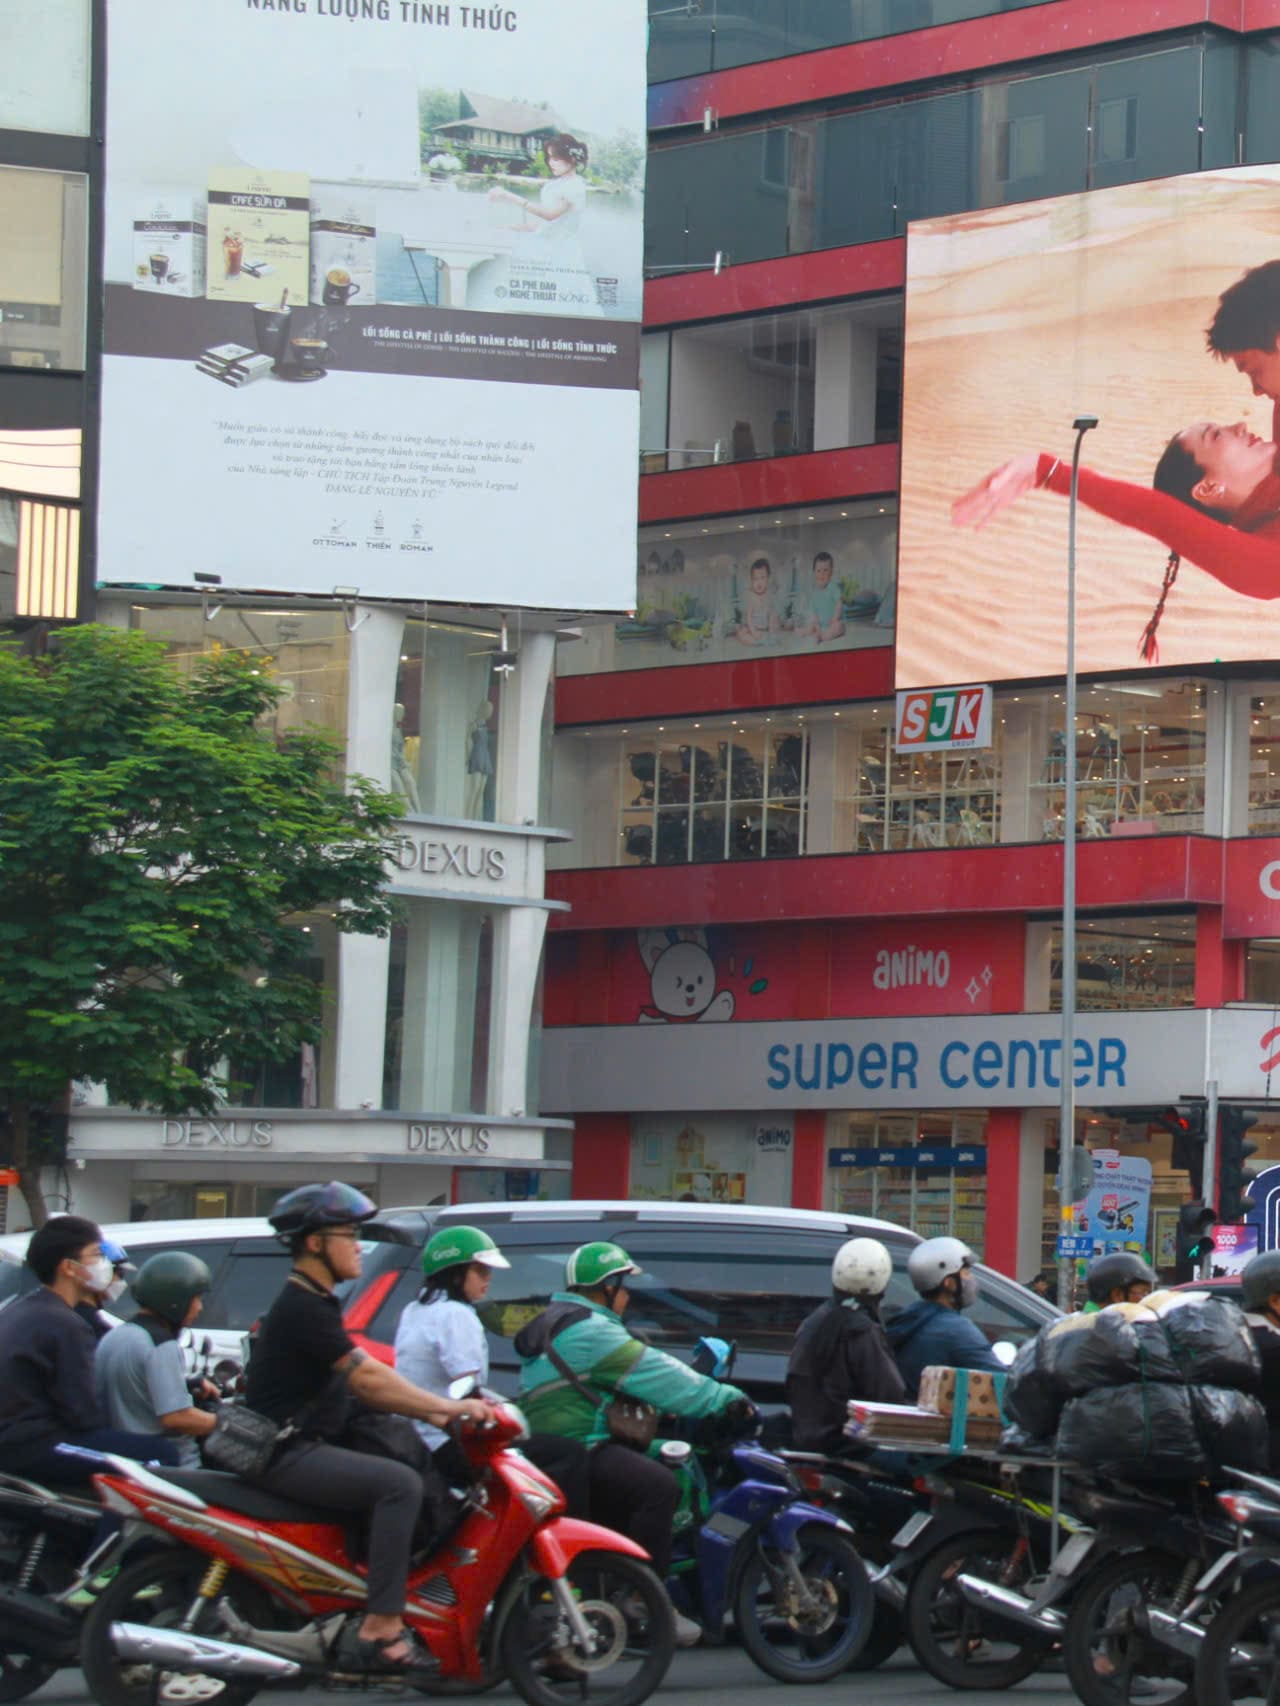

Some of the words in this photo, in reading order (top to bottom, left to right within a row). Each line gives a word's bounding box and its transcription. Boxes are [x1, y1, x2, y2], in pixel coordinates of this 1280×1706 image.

[460, 4, 518, 32] THỨC
[903, 693, 982, 739] SJK
[398, 838, 506, 881] DEXUS
[160, 1119, 273, 1148] DEXUS
[407, 1123, 491, 1154] DEXUS
